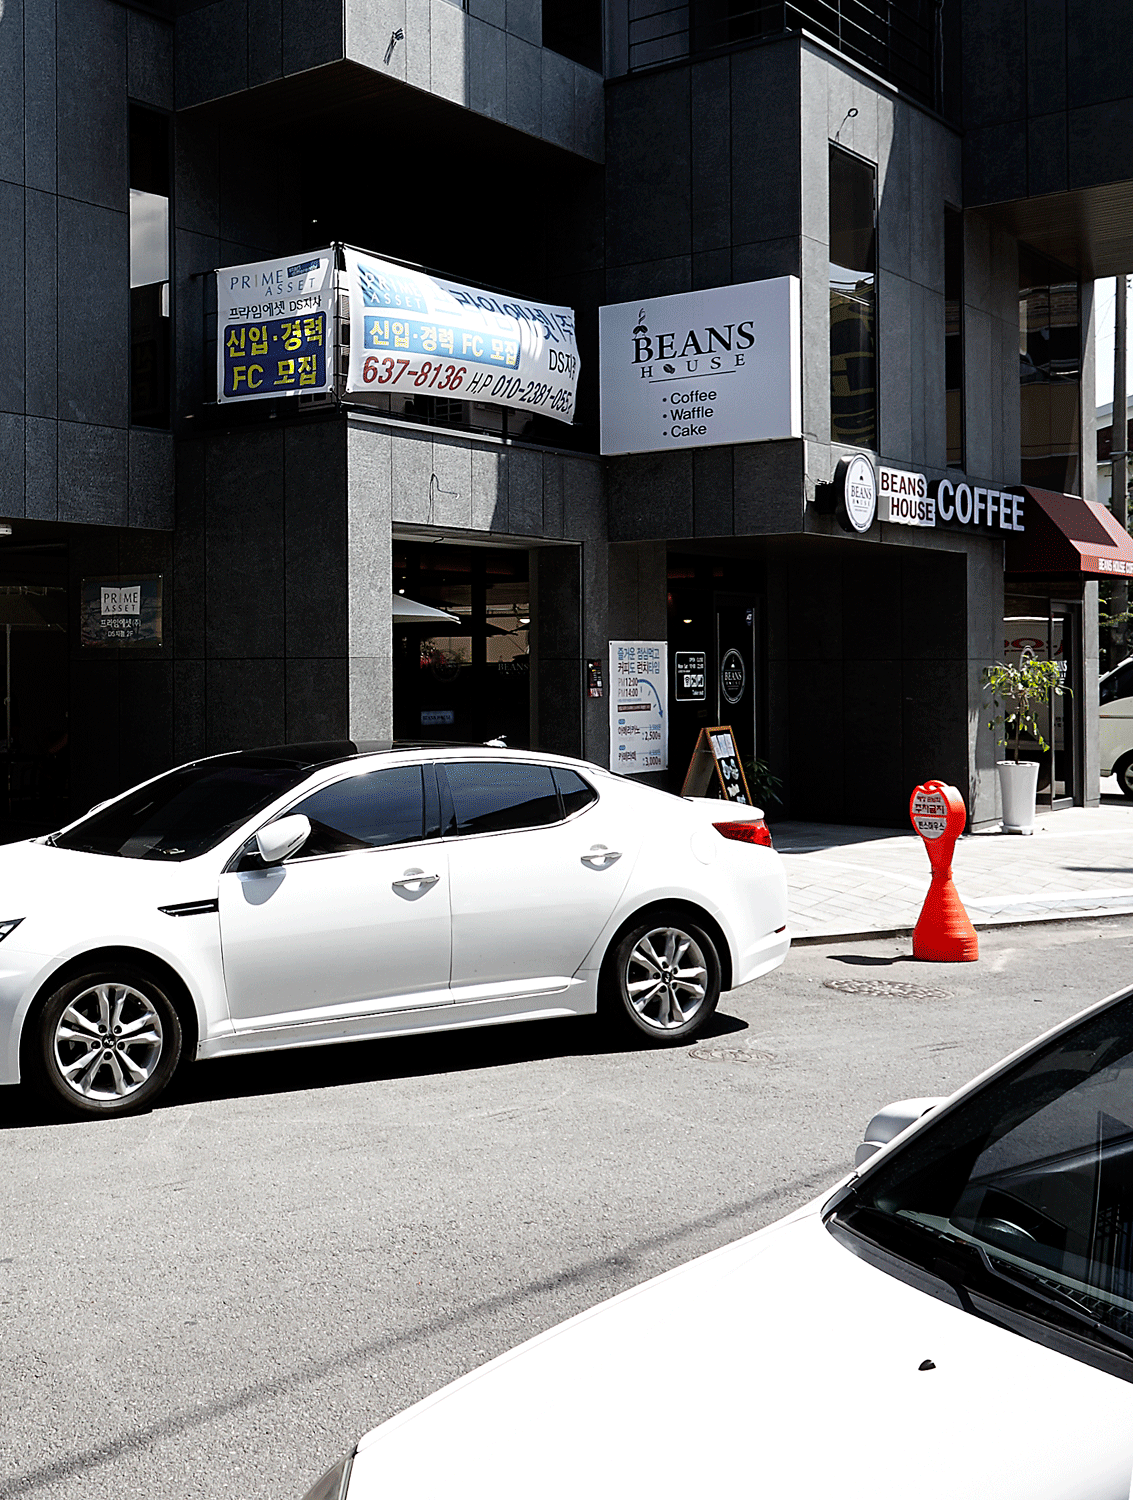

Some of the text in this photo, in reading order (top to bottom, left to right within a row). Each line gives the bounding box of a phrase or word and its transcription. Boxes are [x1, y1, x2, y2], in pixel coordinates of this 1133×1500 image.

[230, 270, 283, 290] PRIME
[265, 278, 315, 296] ASSET
[365, 272, 423, 297] PRIME
[370, 292, 422, 309] ASSET
[228, 301, 285, 320] 프라임에셋
[462, 332, 484, 357] FC
[490, 337, 519, 366] 모집
[631, 320, 756, 365] BEANS
[233, 354, 317, 391] FC 모집
[362, 356, 467, 391] 637-8136
[670, 390, 717, 405] Coffee
[670, 406, 714, 421] Waffle
[670, 424, 707, 438] Cake
[851, 485, 872, 500] BEANS
[881, 471, 925, 498] BEANS
[891, 497, 933, 521] HOUSE
[937, 478, 1025, 531] COFFEE
[103, 592, 138, 603] PRIME
[104, 605, 136, 613] ASSET
[618, 647, 635, 660] 즐거운
[618, 661, 636, 675] 커피도
[725, 671, 742, 680] BEANS
[915, 803, 945, 814] 주차금지
